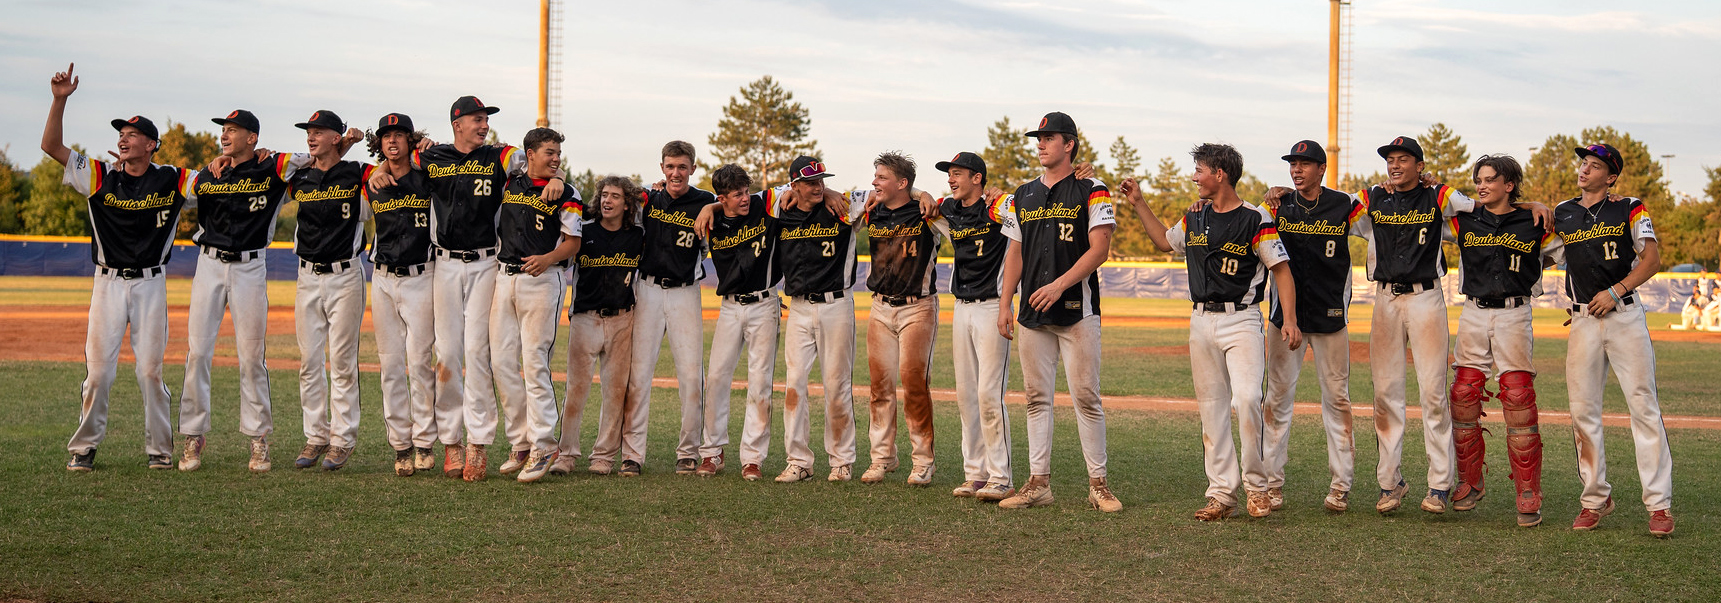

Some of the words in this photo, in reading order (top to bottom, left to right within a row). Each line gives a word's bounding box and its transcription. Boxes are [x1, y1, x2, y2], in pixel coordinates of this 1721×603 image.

[226, 110, 239, 119] D
[308, 112, 320, 122] D
[387, 114, 398, 126] D
[1038, 117, 1048, 129] D
[1296, 142, 1308, 153] D
[427, 160, 496, 178] Deutschland
[198, 176, 271, 195] Deutschland
[294, 184, 358, 202] Deutschland
[474, 178, 492, 196] 26
[104, 191, 174, 210] Deutschland
[248, 195, 268, 212] 29
[156, 210, 171, 228] 15
[342, 202, 351, 219] 9
[1020, 202, 1082, 224] Deutschland
[1370, 207, 1436, 224] Deutschland
[414, 212, 428, 228] 13
[534, 214, 545, 231] 5
[1278, 216, 1346, 236] Deutschland
[676, 230, 696, 248] 28
[1058, 222, 1074, 242] 32
[1418, 227, 1428, 245] 6
[1558, 221, 1626, 246] Deutschland
[821, 240, 836, 257] 21
[902, 240, 918, 258] 14
[974, 240, 984, 257] 7
[1324, 240, 1337, 258] 8
[1463, 231, 1536, 254] Deutschland
[1602, 240, 1620, 261] 12
[579, 252, 641, 268] Deutschland
[1220, 256, 1239, 276] 10
[1508, 254, 1522, 273] 11
[623, 271, 632, 288] 4
